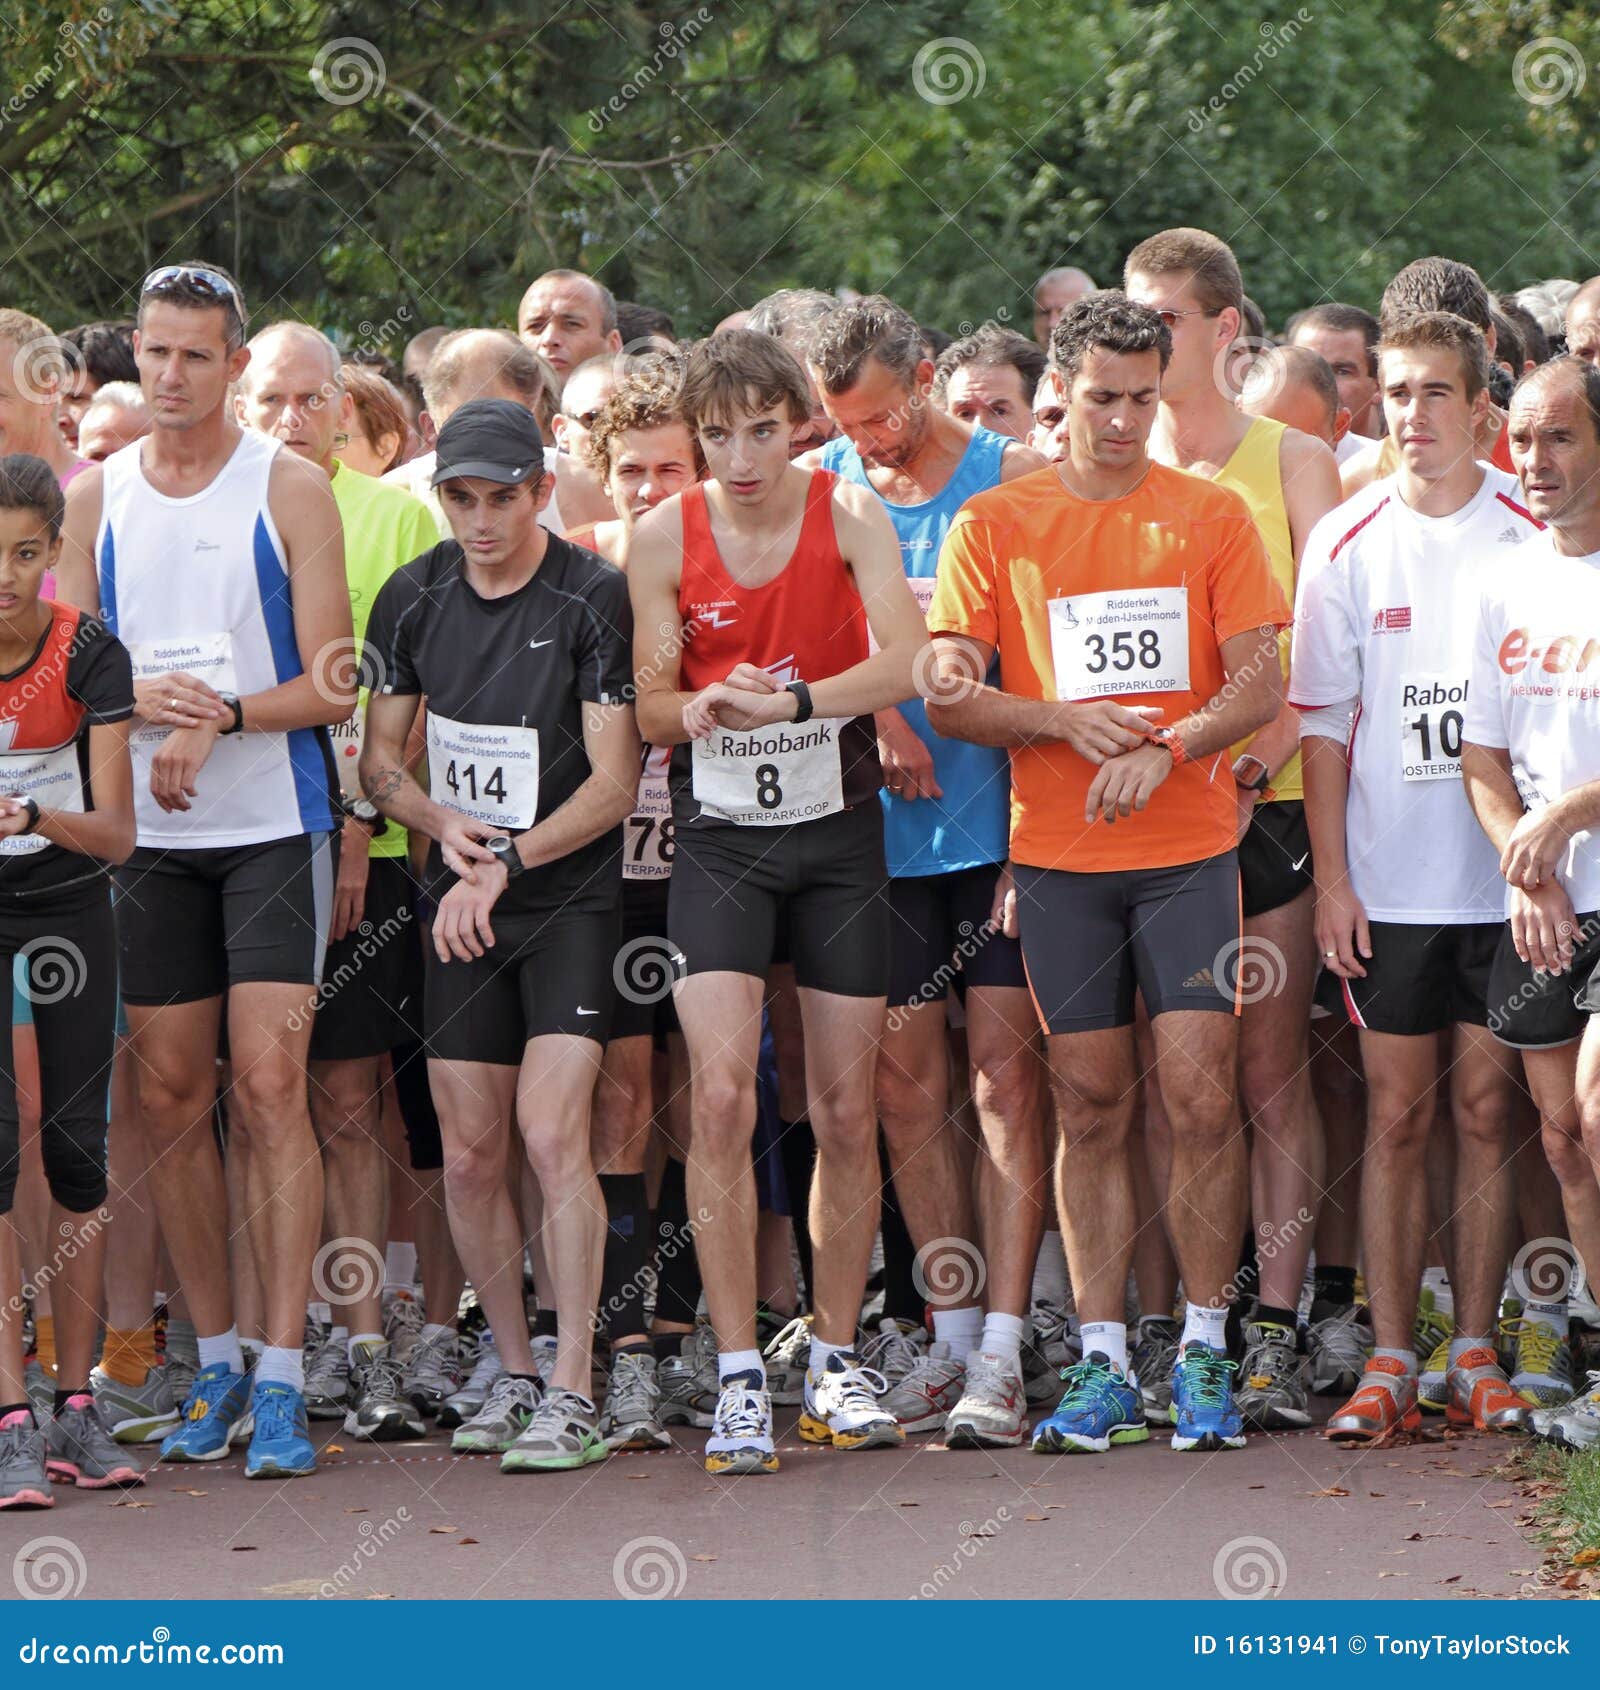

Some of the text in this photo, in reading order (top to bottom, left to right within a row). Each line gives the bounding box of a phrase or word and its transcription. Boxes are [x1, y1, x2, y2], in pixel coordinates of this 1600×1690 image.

[1107, 598, 1159, 610] Ridderkerk
[153, 644, 201, 659] Ridderkerk
[1085, 630, 1162, 674] 358
[1075, 679, 1176, 696] OOSTERPARKLOOP
[459, 732, 508, 746] Ridderkerk
[721, 724, 832, 758] Rabobank
[0, 763, 47, 779] idderkerk
[446, 760, 508, 804] 414
[755, 763, 783, 810] 8
[629, 816, 675, 863] 78
